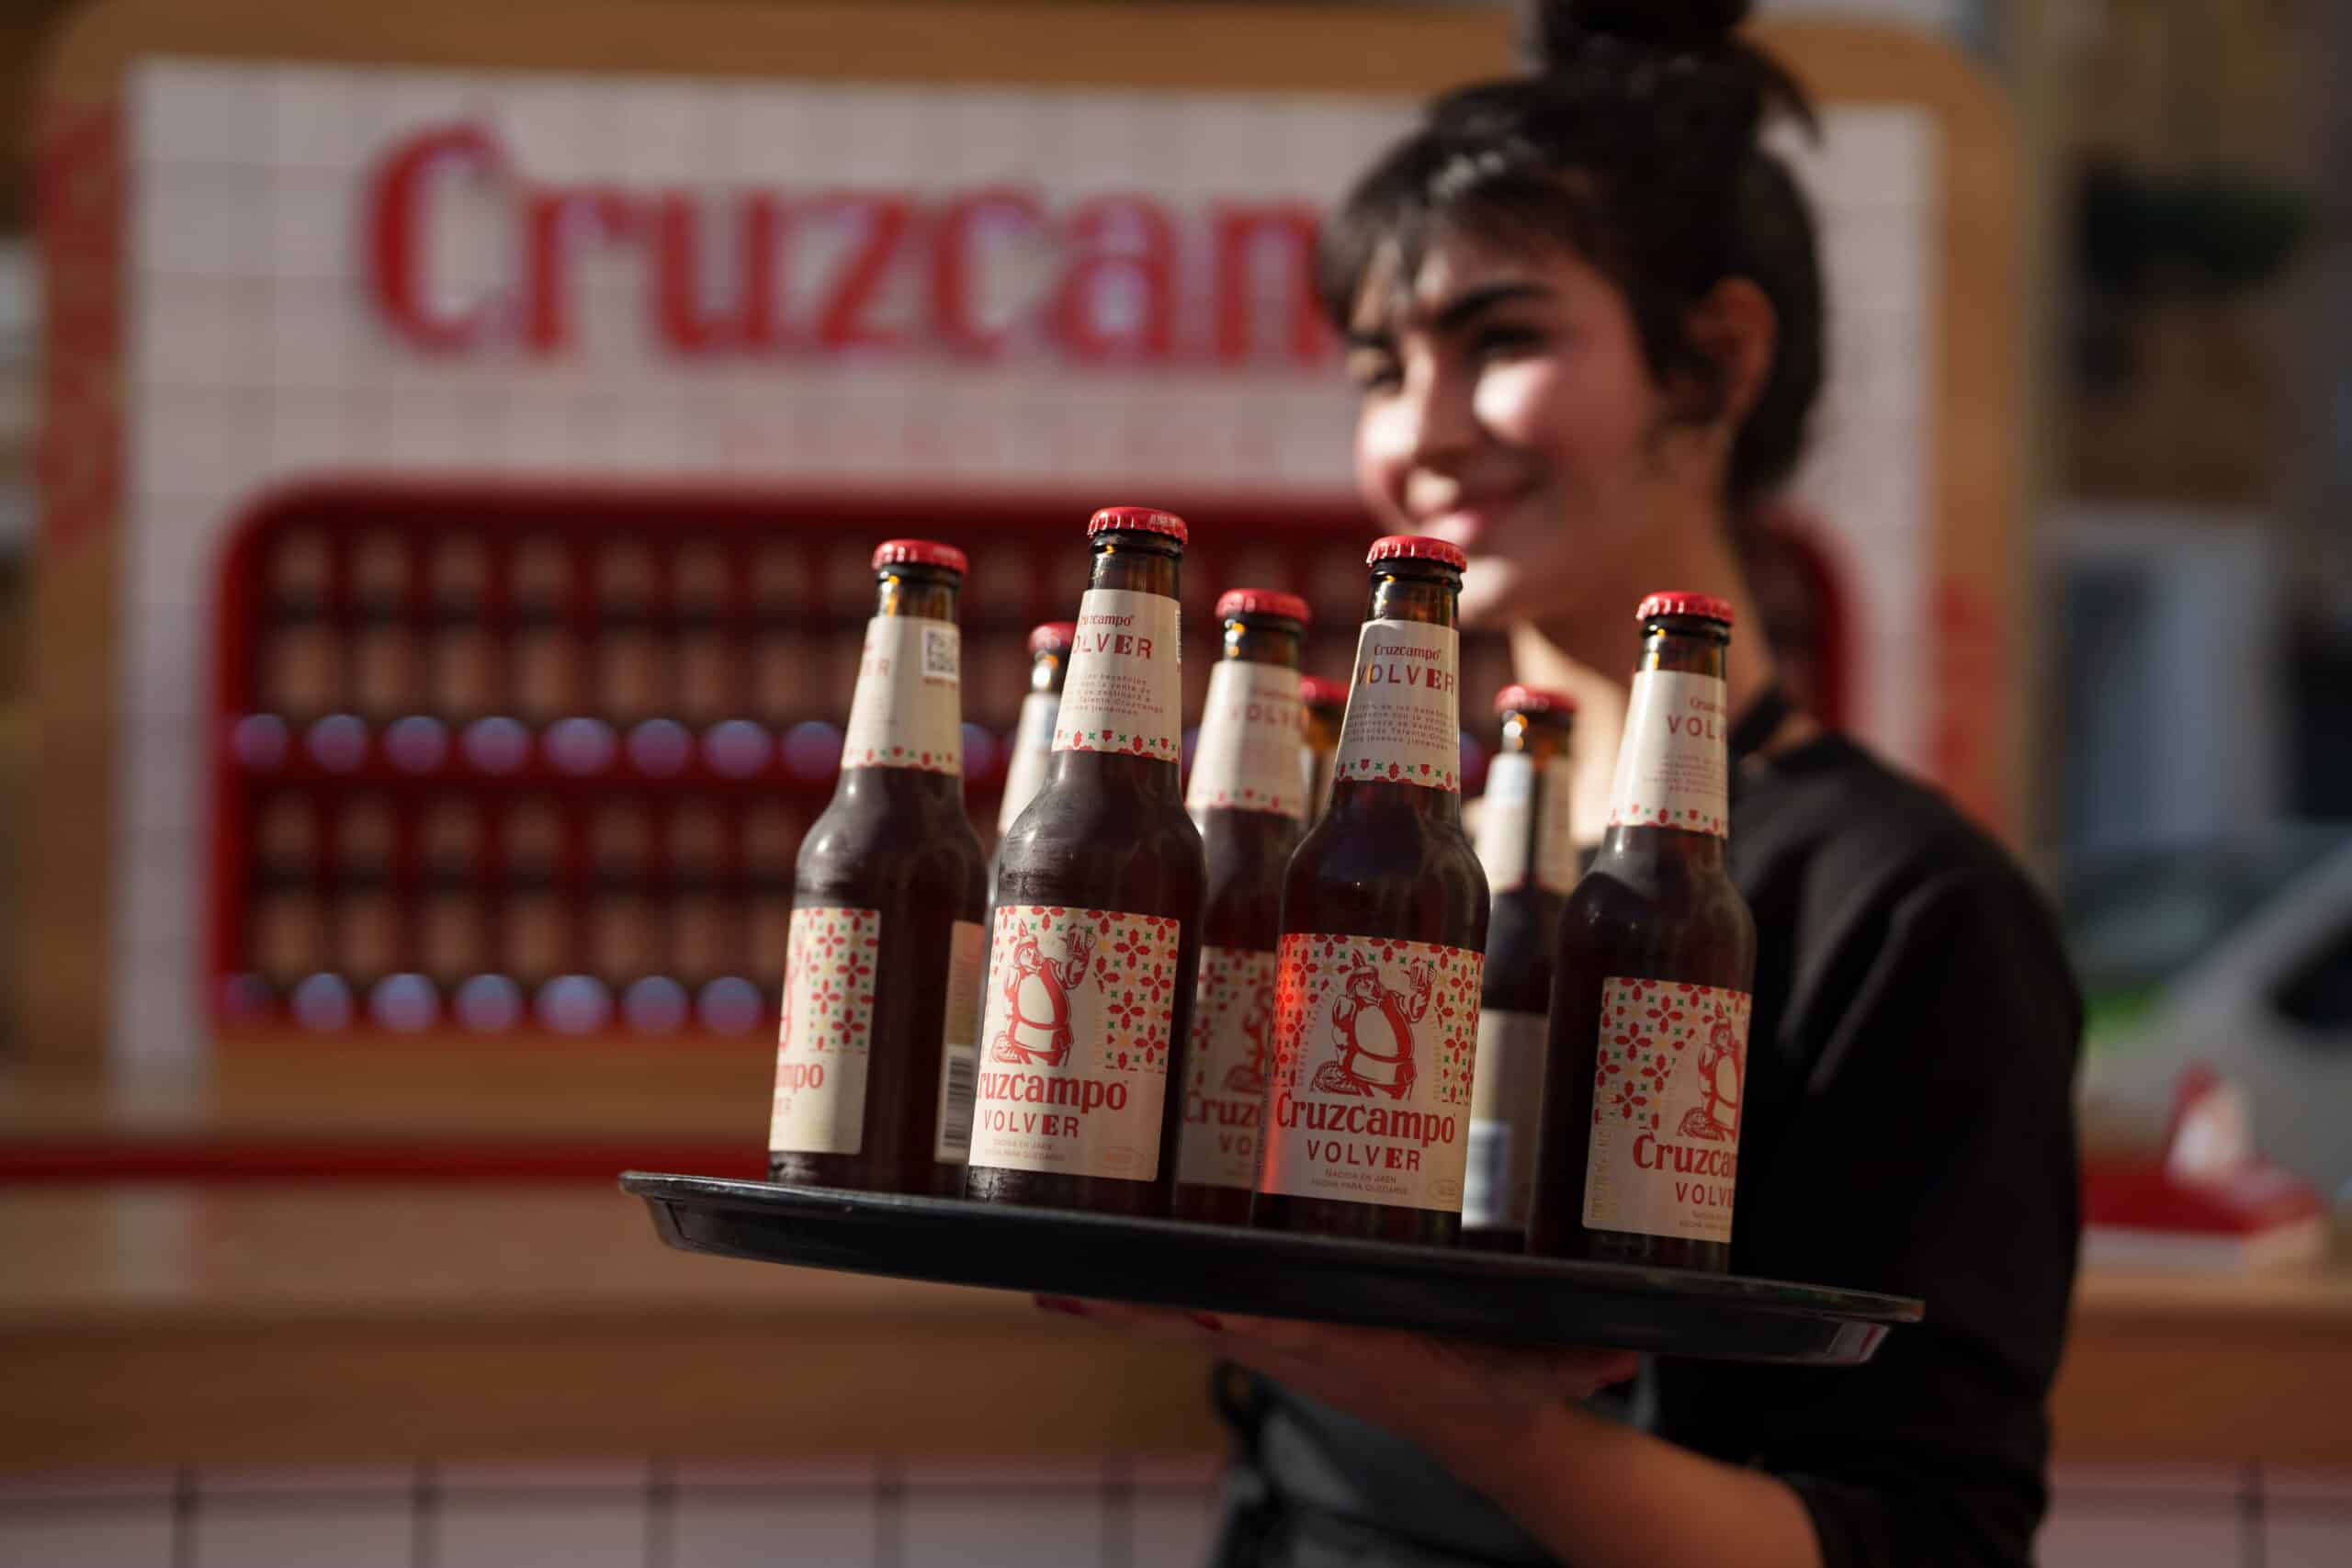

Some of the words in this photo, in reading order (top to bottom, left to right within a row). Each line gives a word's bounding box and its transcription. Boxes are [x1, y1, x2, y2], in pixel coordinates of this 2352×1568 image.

[1071, 632, 1154, 660] OLVER
[1374, 643, 1441, 661] Cruzcampo
[1355, 661, 1454, 695] VOLVER
[1668, 715, 1725, 742] VOL
[977, 1072, 1126, 1114] ruzcampo
[984, 1109, 1080, 1138] VOLVER
[1276, 1091, 1455, 1148] Cruzcampo
[1306, 1139, 1420, 1172] VOLVER
[1633, 1130, 1737, 1178] Cruzca
